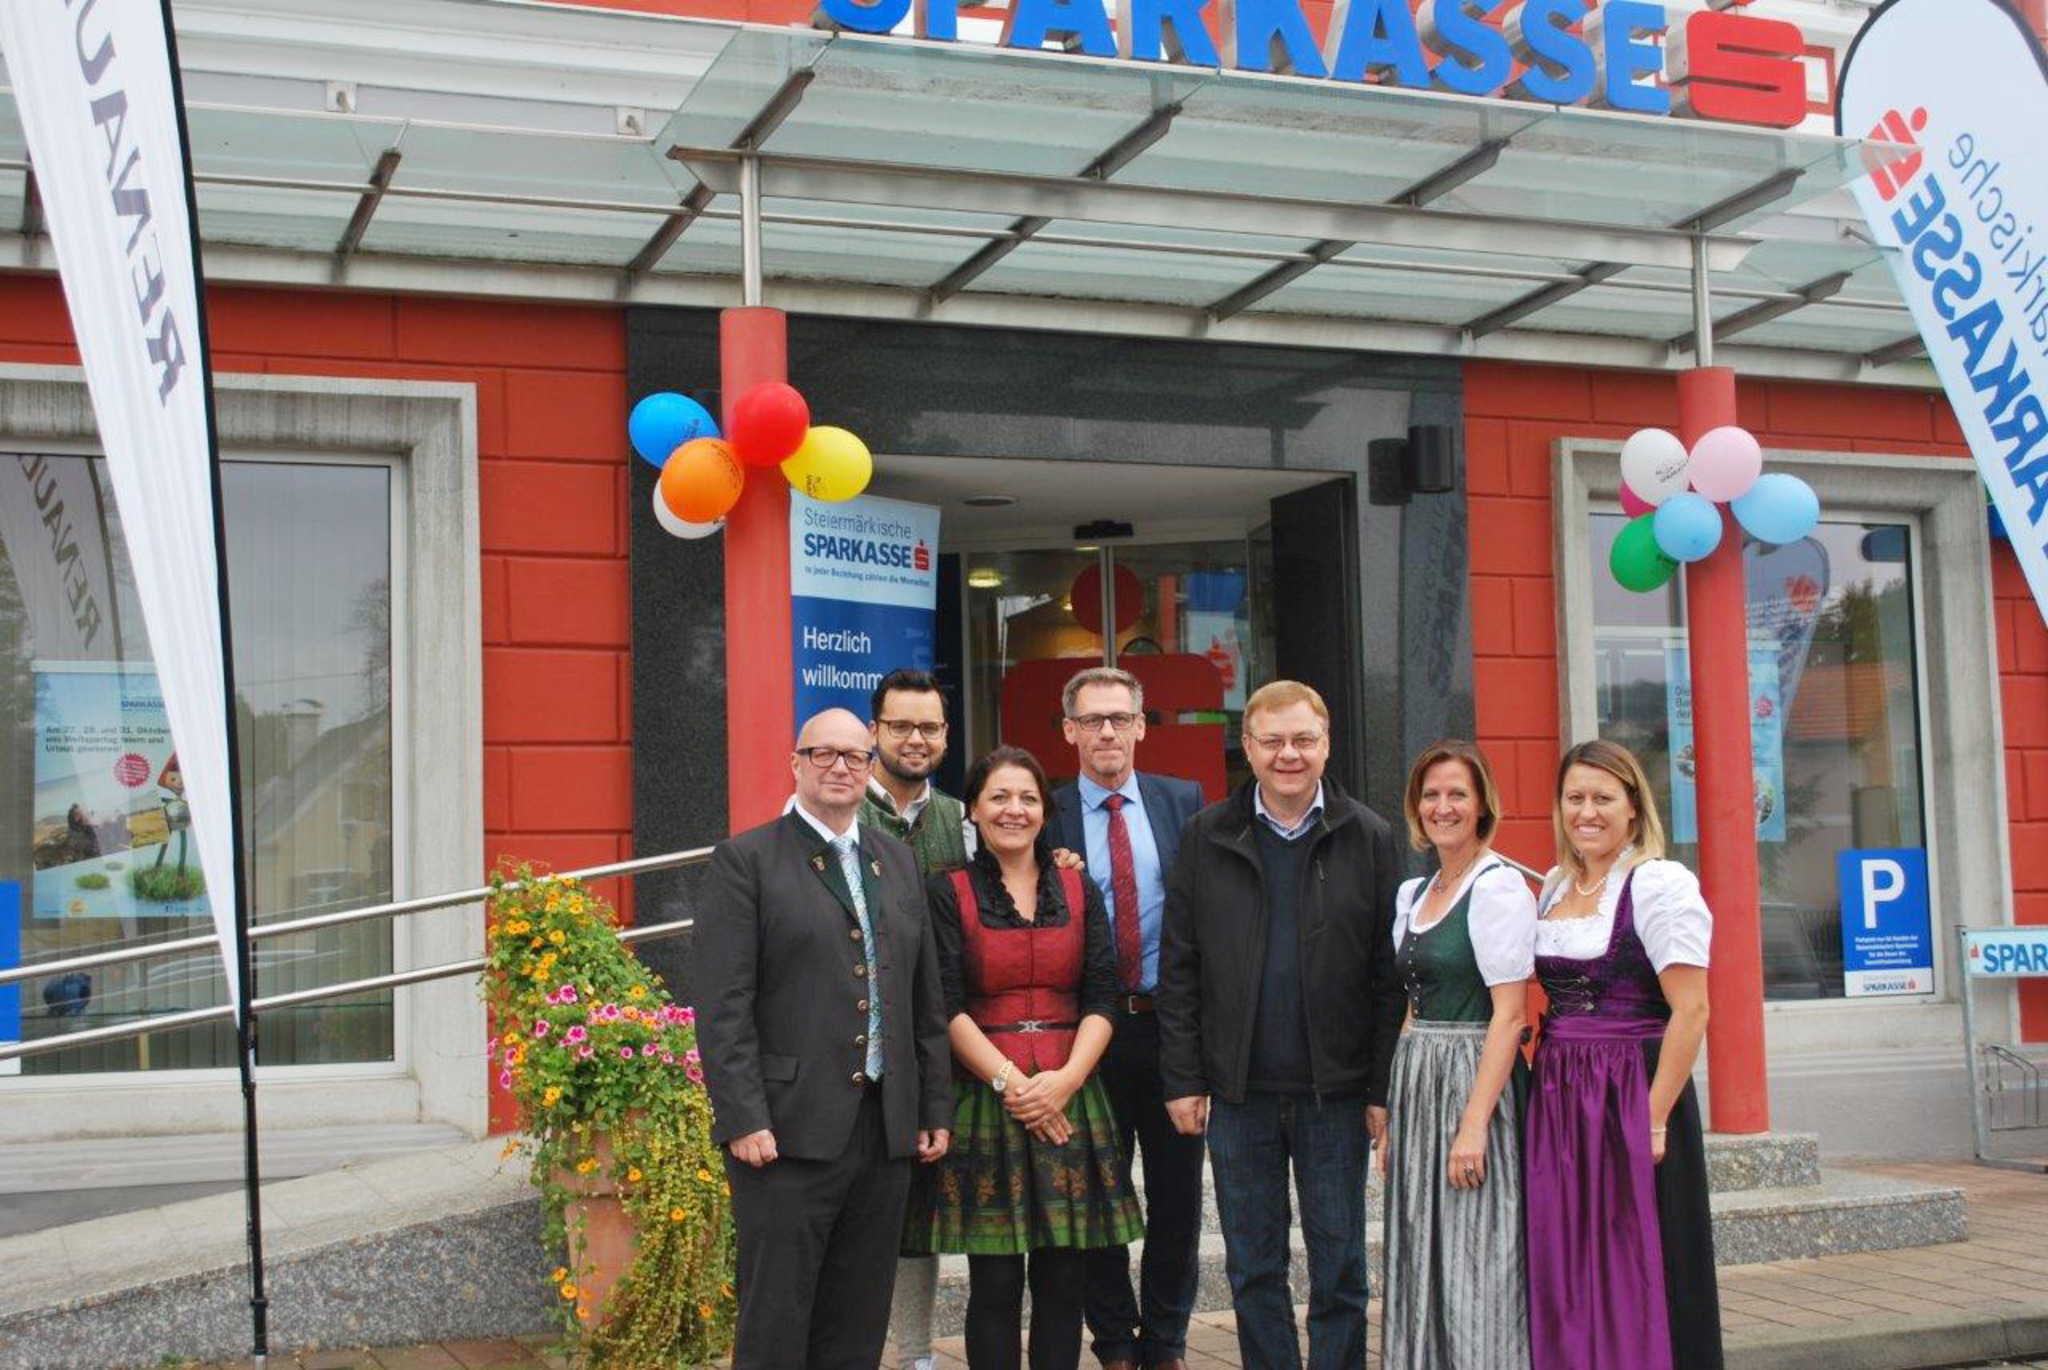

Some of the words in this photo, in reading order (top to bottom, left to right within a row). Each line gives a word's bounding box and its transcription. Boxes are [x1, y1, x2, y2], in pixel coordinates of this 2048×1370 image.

[804, 507, 912, 539] Steiermärkische
[804, 533, 912, 569] SPARKASSE
[803, 625, 871, 654] Herzlich
[1861, 858, 1906, 929] P
[1983, 944, 2048, 973] SPAR
